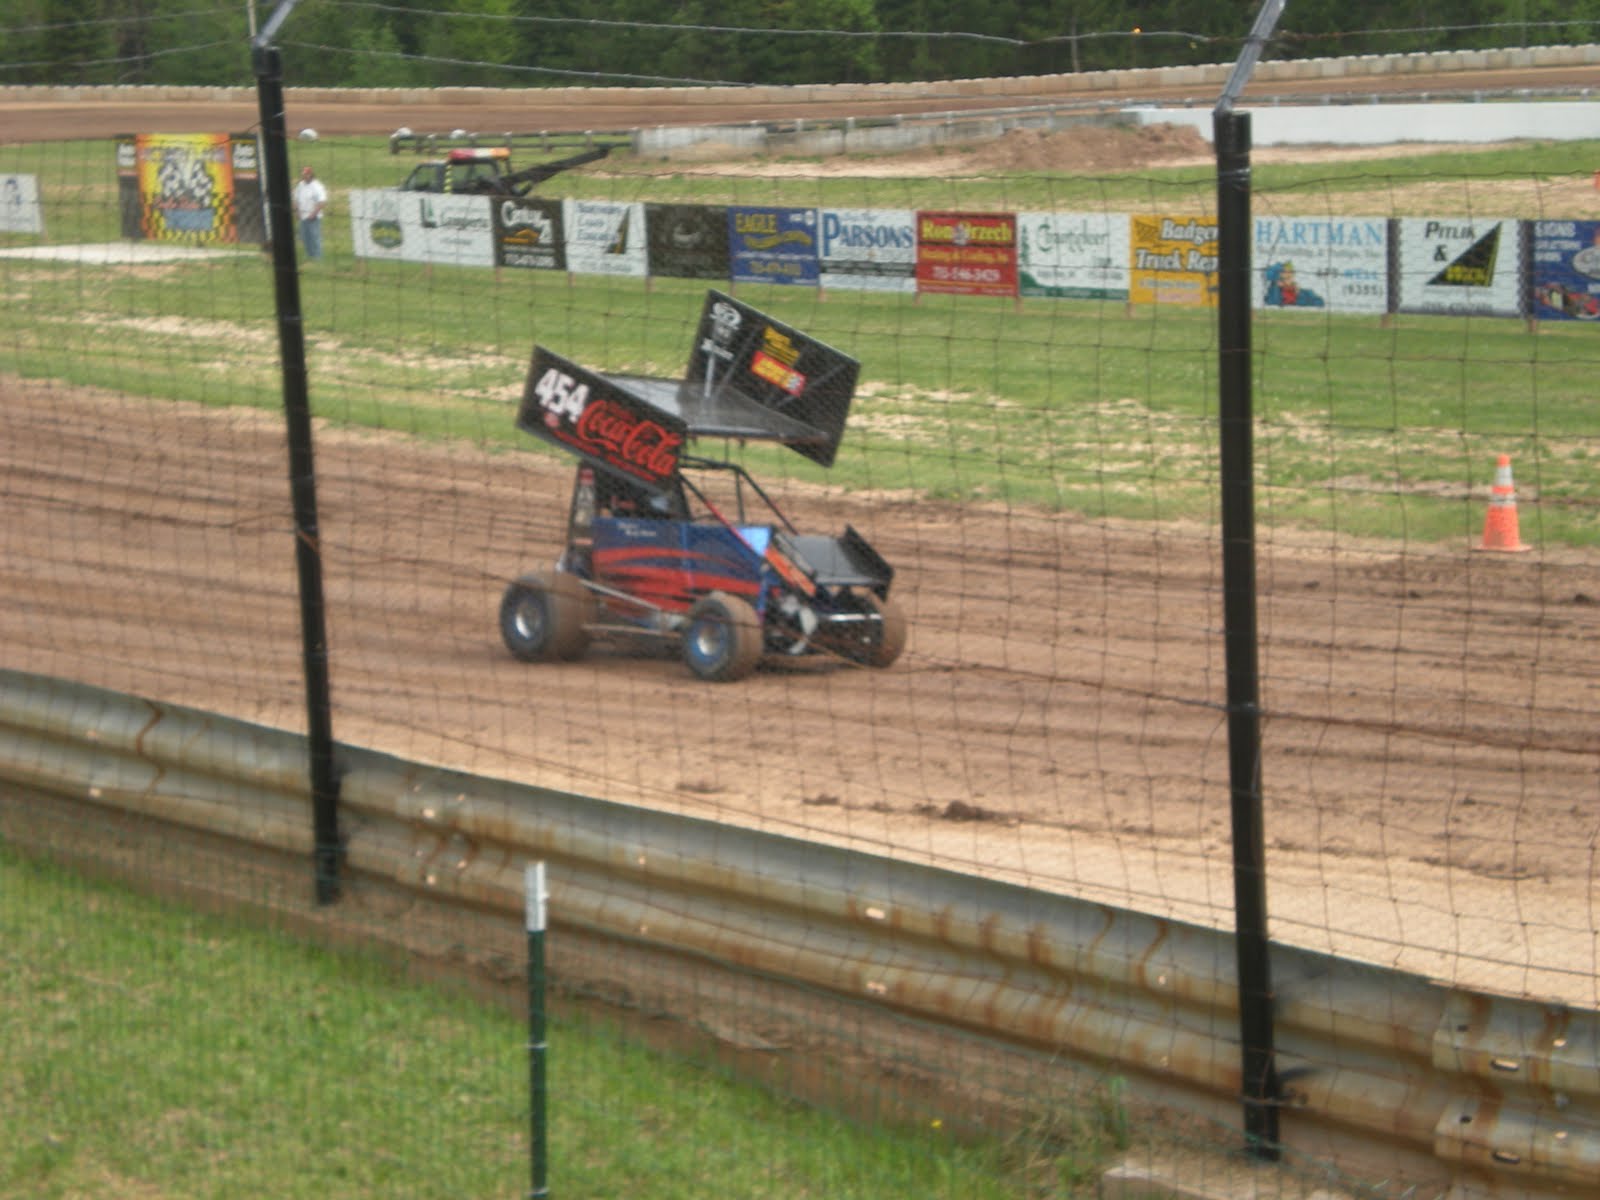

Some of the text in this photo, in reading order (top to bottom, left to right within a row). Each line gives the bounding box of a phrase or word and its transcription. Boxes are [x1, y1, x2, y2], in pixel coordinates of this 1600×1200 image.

[735, 212, 777, 234] EAGLE
[823, 212, 914, 256] PARSONS
[1256, 220, 1382, 245] HARTMAN
[1135, 248, 1181, 270] Truck
[1434, 244, 1447, 262] &
[534, 367, 590, 424] 454
